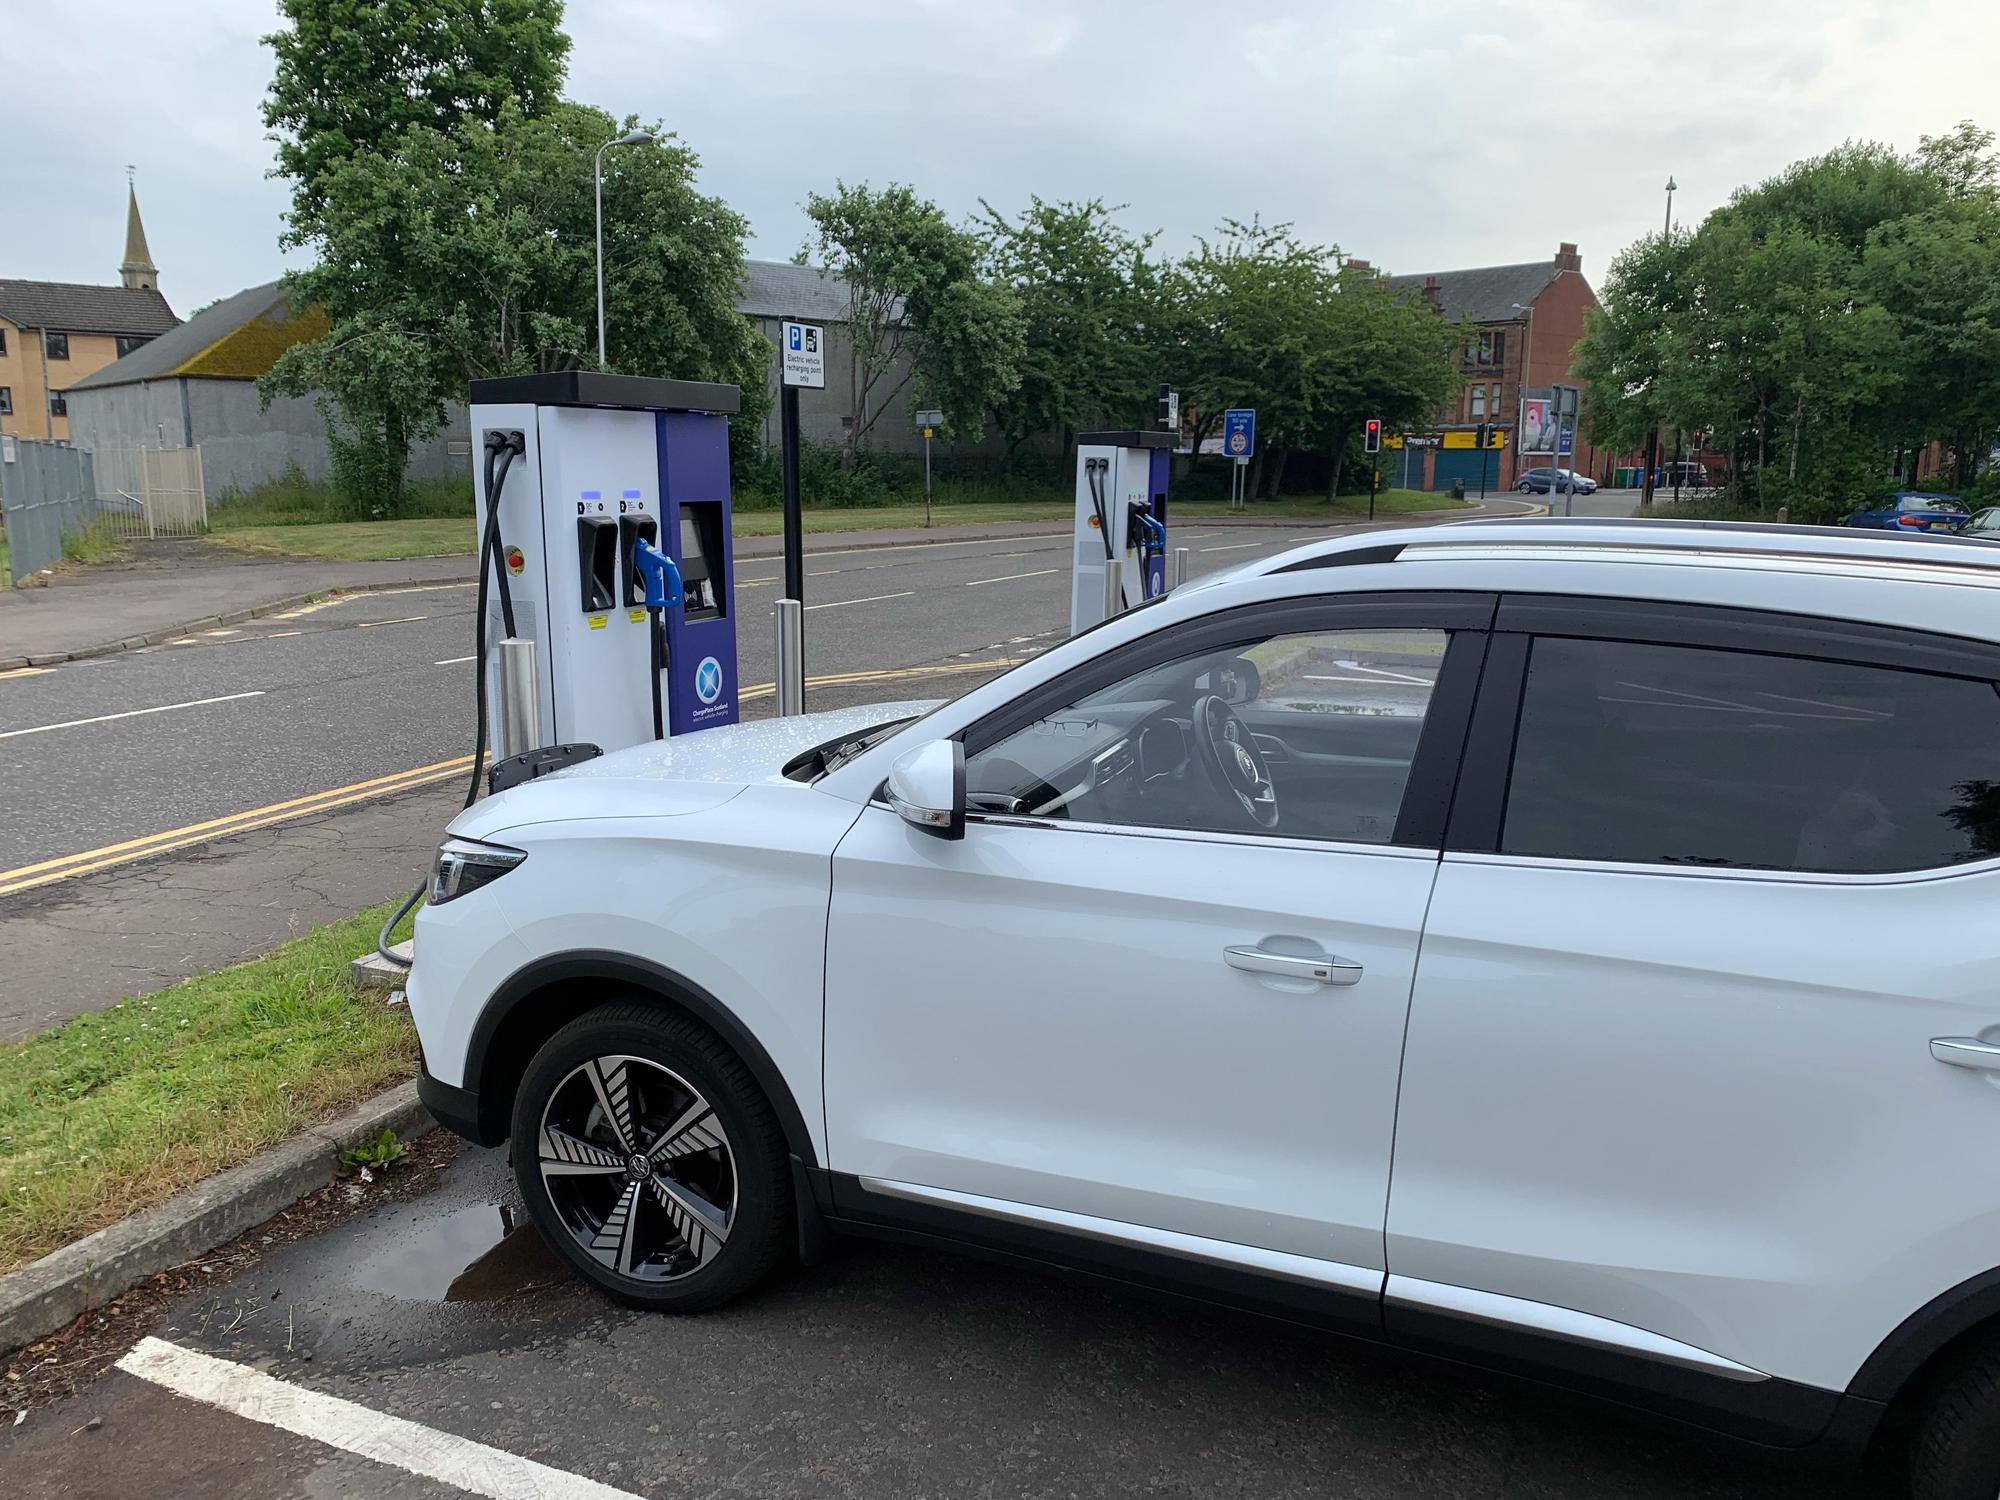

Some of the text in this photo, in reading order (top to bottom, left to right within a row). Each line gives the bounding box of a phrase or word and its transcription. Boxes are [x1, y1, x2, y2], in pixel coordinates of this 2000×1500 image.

[791, 327, 799, 348] P
[787, 353, 804, 363] Electric
[786, 364, 809, 374] recharging
[800, 375, 809, 384] only
[693, 702, 728, 717] ChargePlace Scotland
